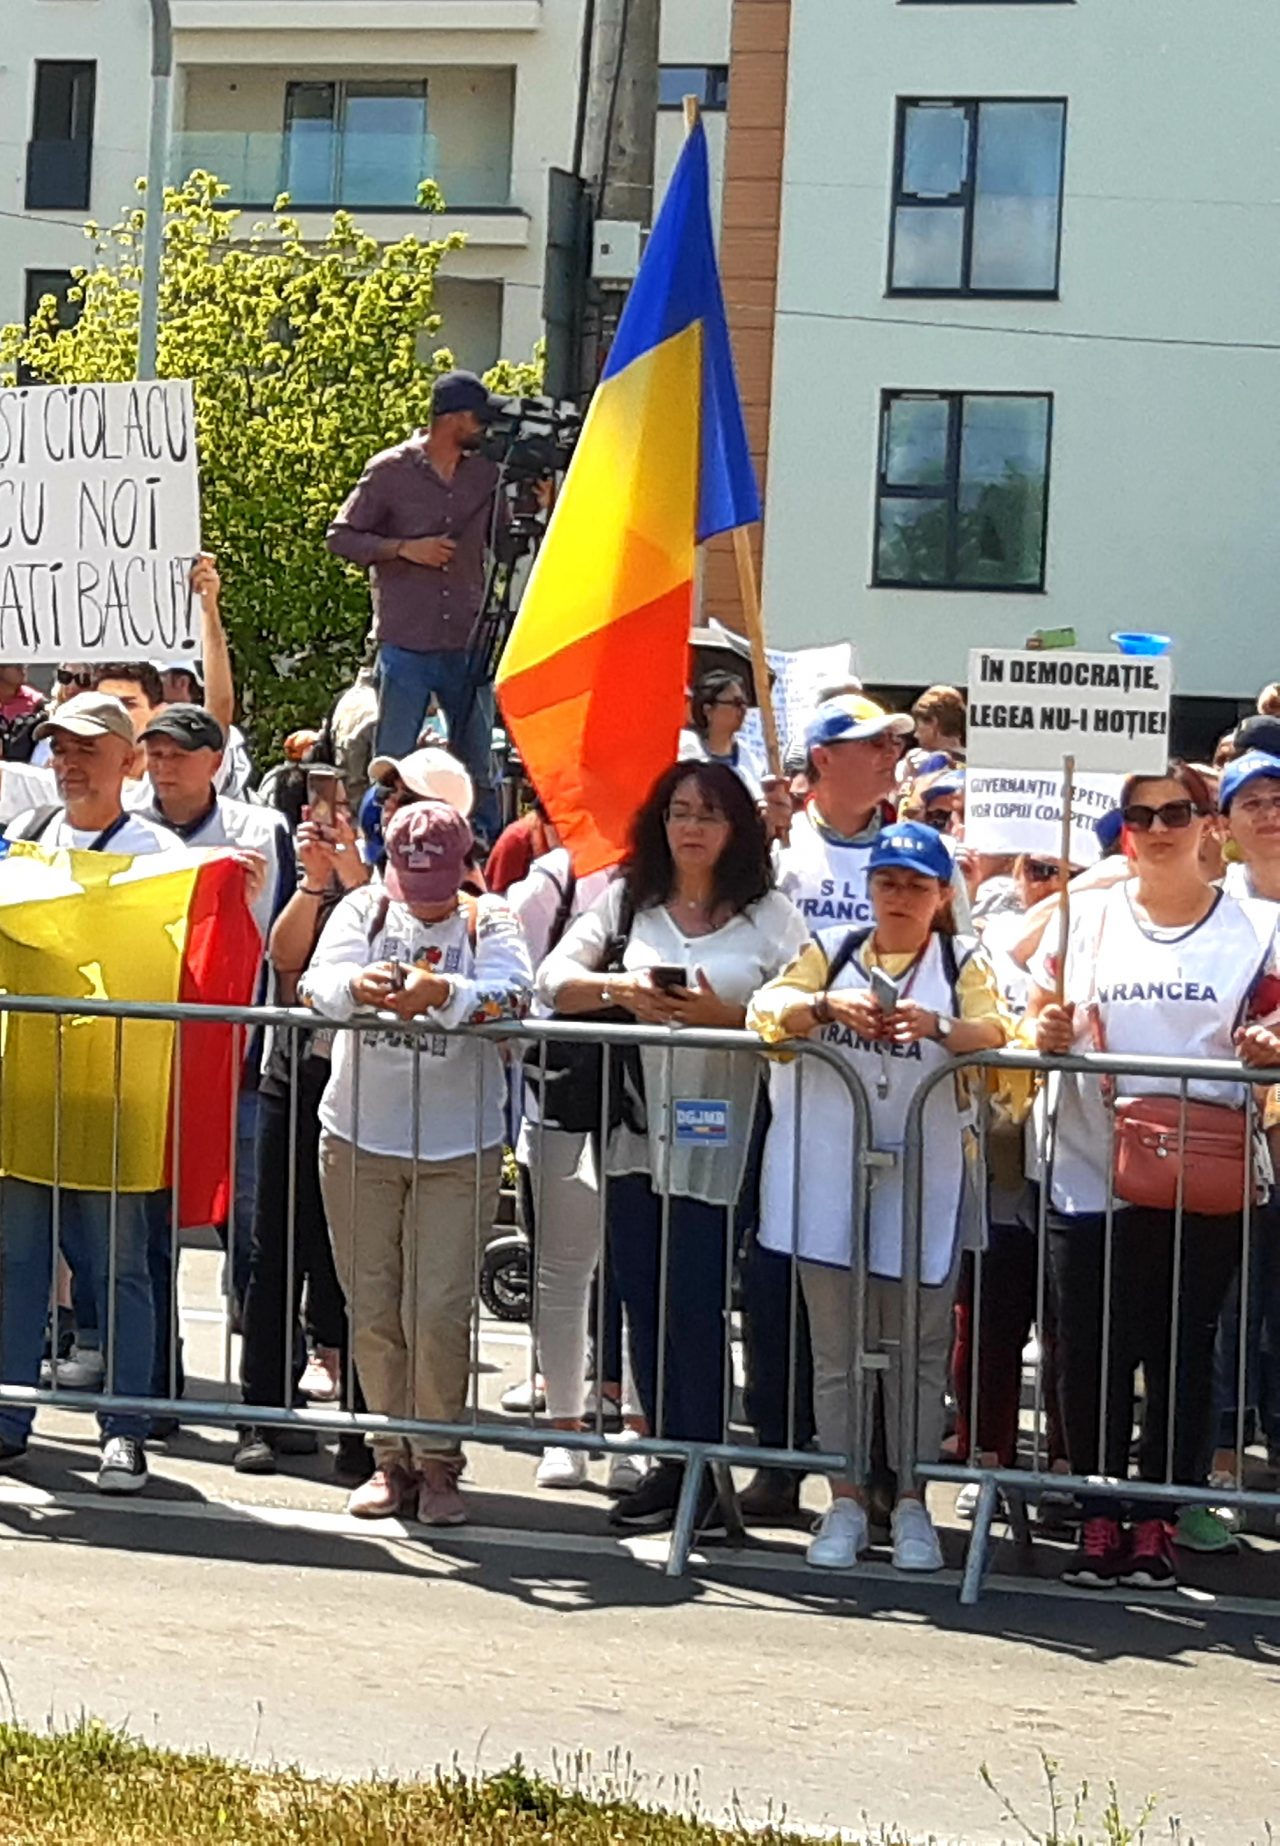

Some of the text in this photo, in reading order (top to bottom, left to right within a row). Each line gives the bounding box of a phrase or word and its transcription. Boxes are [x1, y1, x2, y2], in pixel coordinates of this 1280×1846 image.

[44, 386, 187, 462] CIOLACU
[980, 655, 1004, 682] ÎN
[970, 704, 1167, 739] LEGEA NU-I HOȚIE!
[1097, 981, 1218, 1004] VRANCEA
